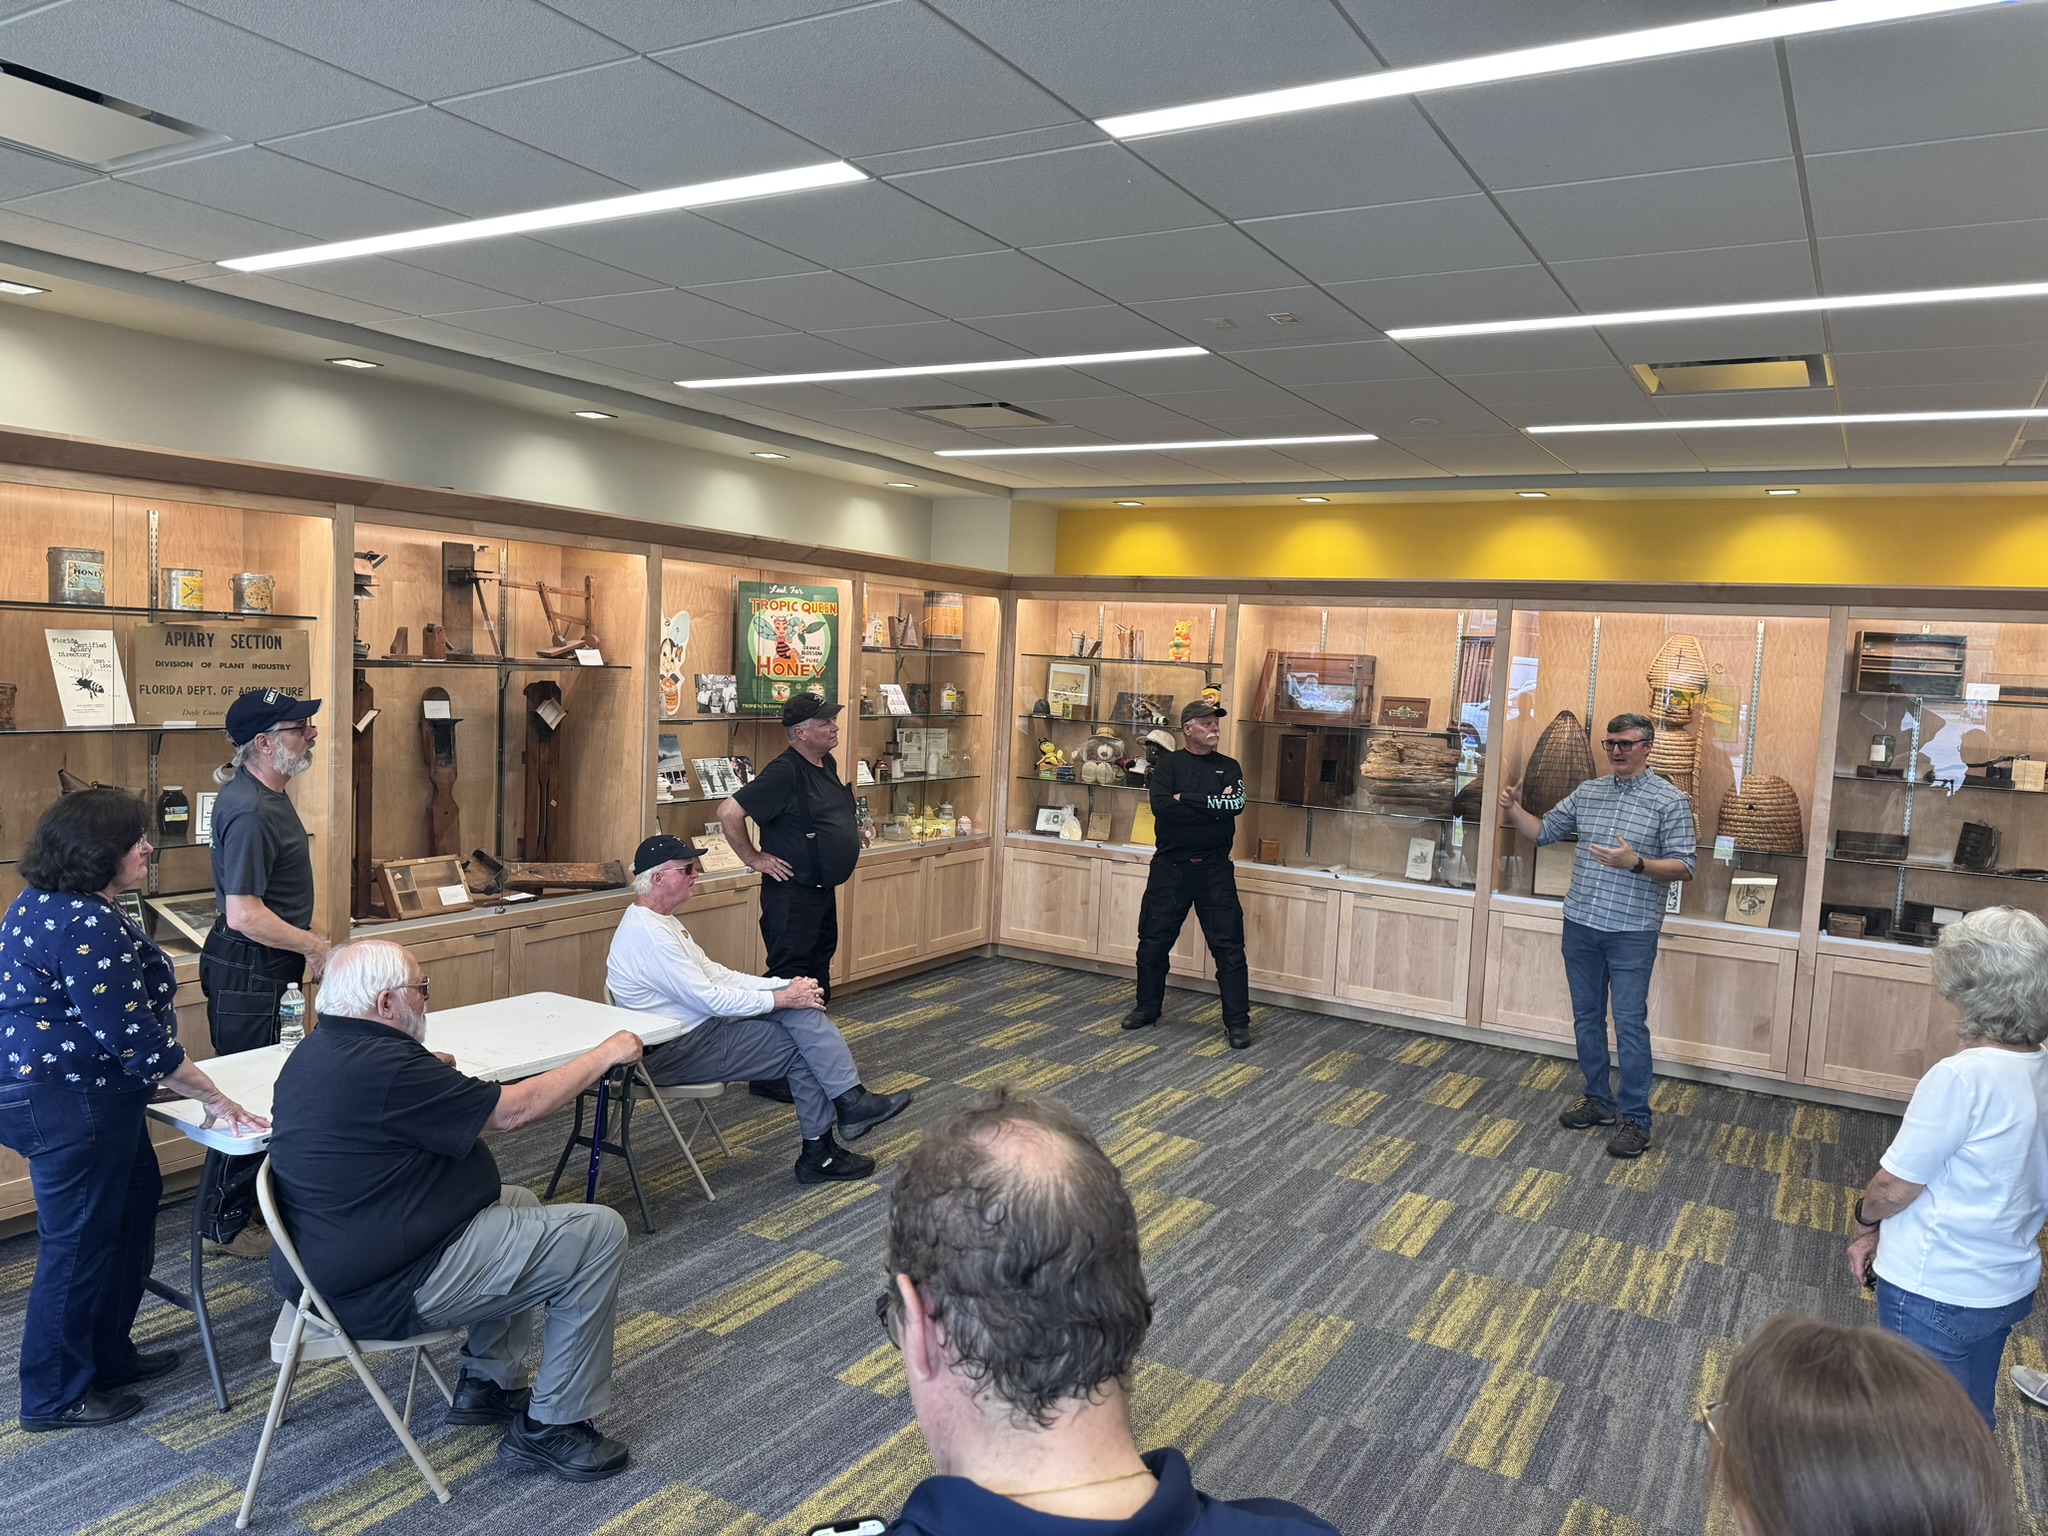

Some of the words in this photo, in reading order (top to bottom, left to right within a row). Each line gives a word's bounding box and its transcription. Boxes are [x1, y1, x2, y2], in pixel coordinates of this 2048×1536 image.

[749, 598, 798, 614] TROPIC
[801, 601, 838, 616] QUEEN
[165, 631, 215, 648] APIARY
[230, 633, 283, 650] SECTION
[155, 660, 194, 668] DIVISION
[201, 661, 213, 669] OF
[219, 662, 245, 670] PLANT
[251, 663, 292, 671] INDUSTRY
[756, 655, 826, 678] HONEY
[139, 684, 183, 696] FLORIDA
[187, 685, 217, 696] DEPT.
[220, 686, 234, 697] OF
[239, 686, 304, 697] AGRTURE
